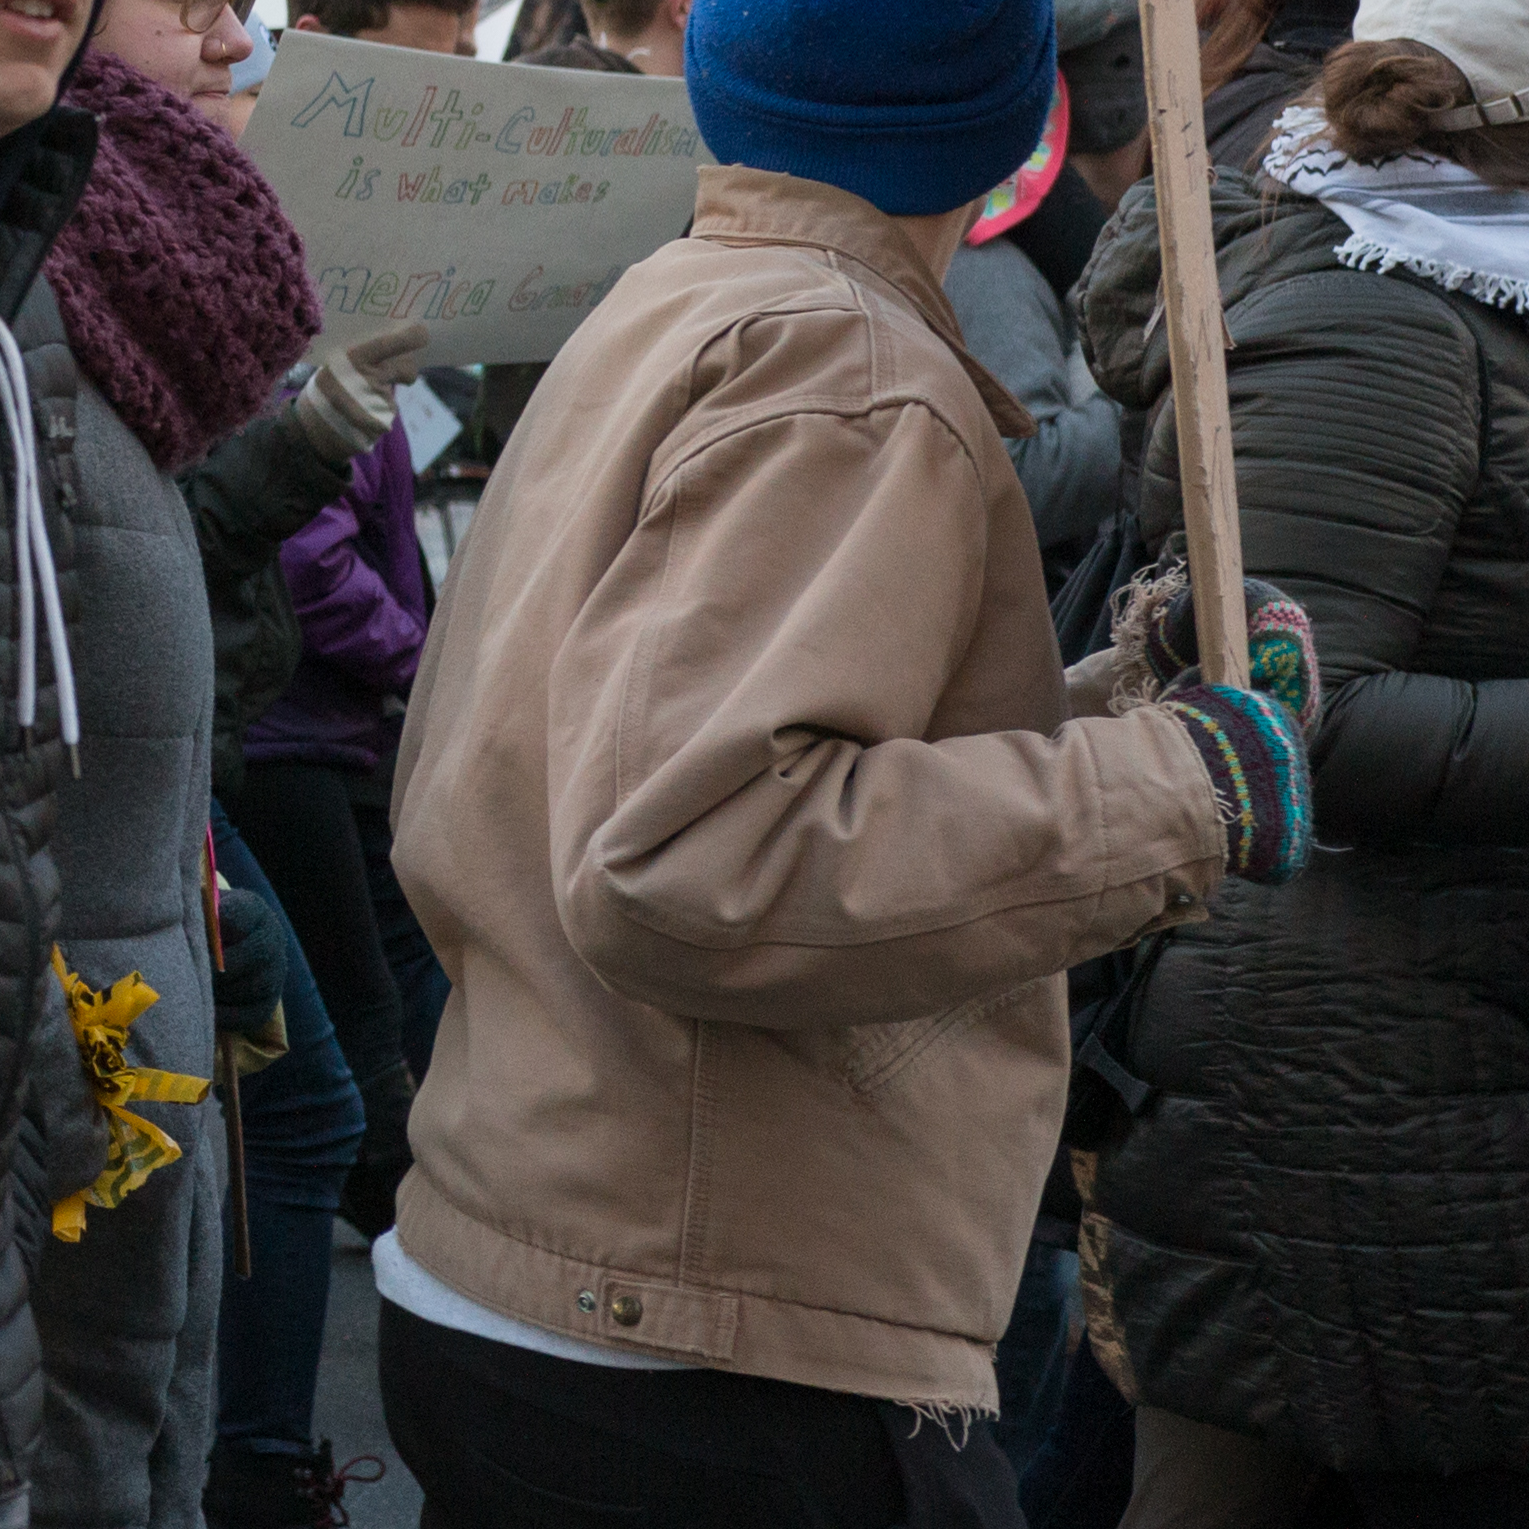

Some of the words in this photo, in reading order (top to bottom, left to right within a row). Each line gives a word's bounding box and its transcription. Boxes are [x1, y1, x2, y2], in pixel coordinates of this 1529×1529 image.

[335, 155, 382, 201] is
[397, 166, 492, 206] what
[501, 173, 611, 206] makes
